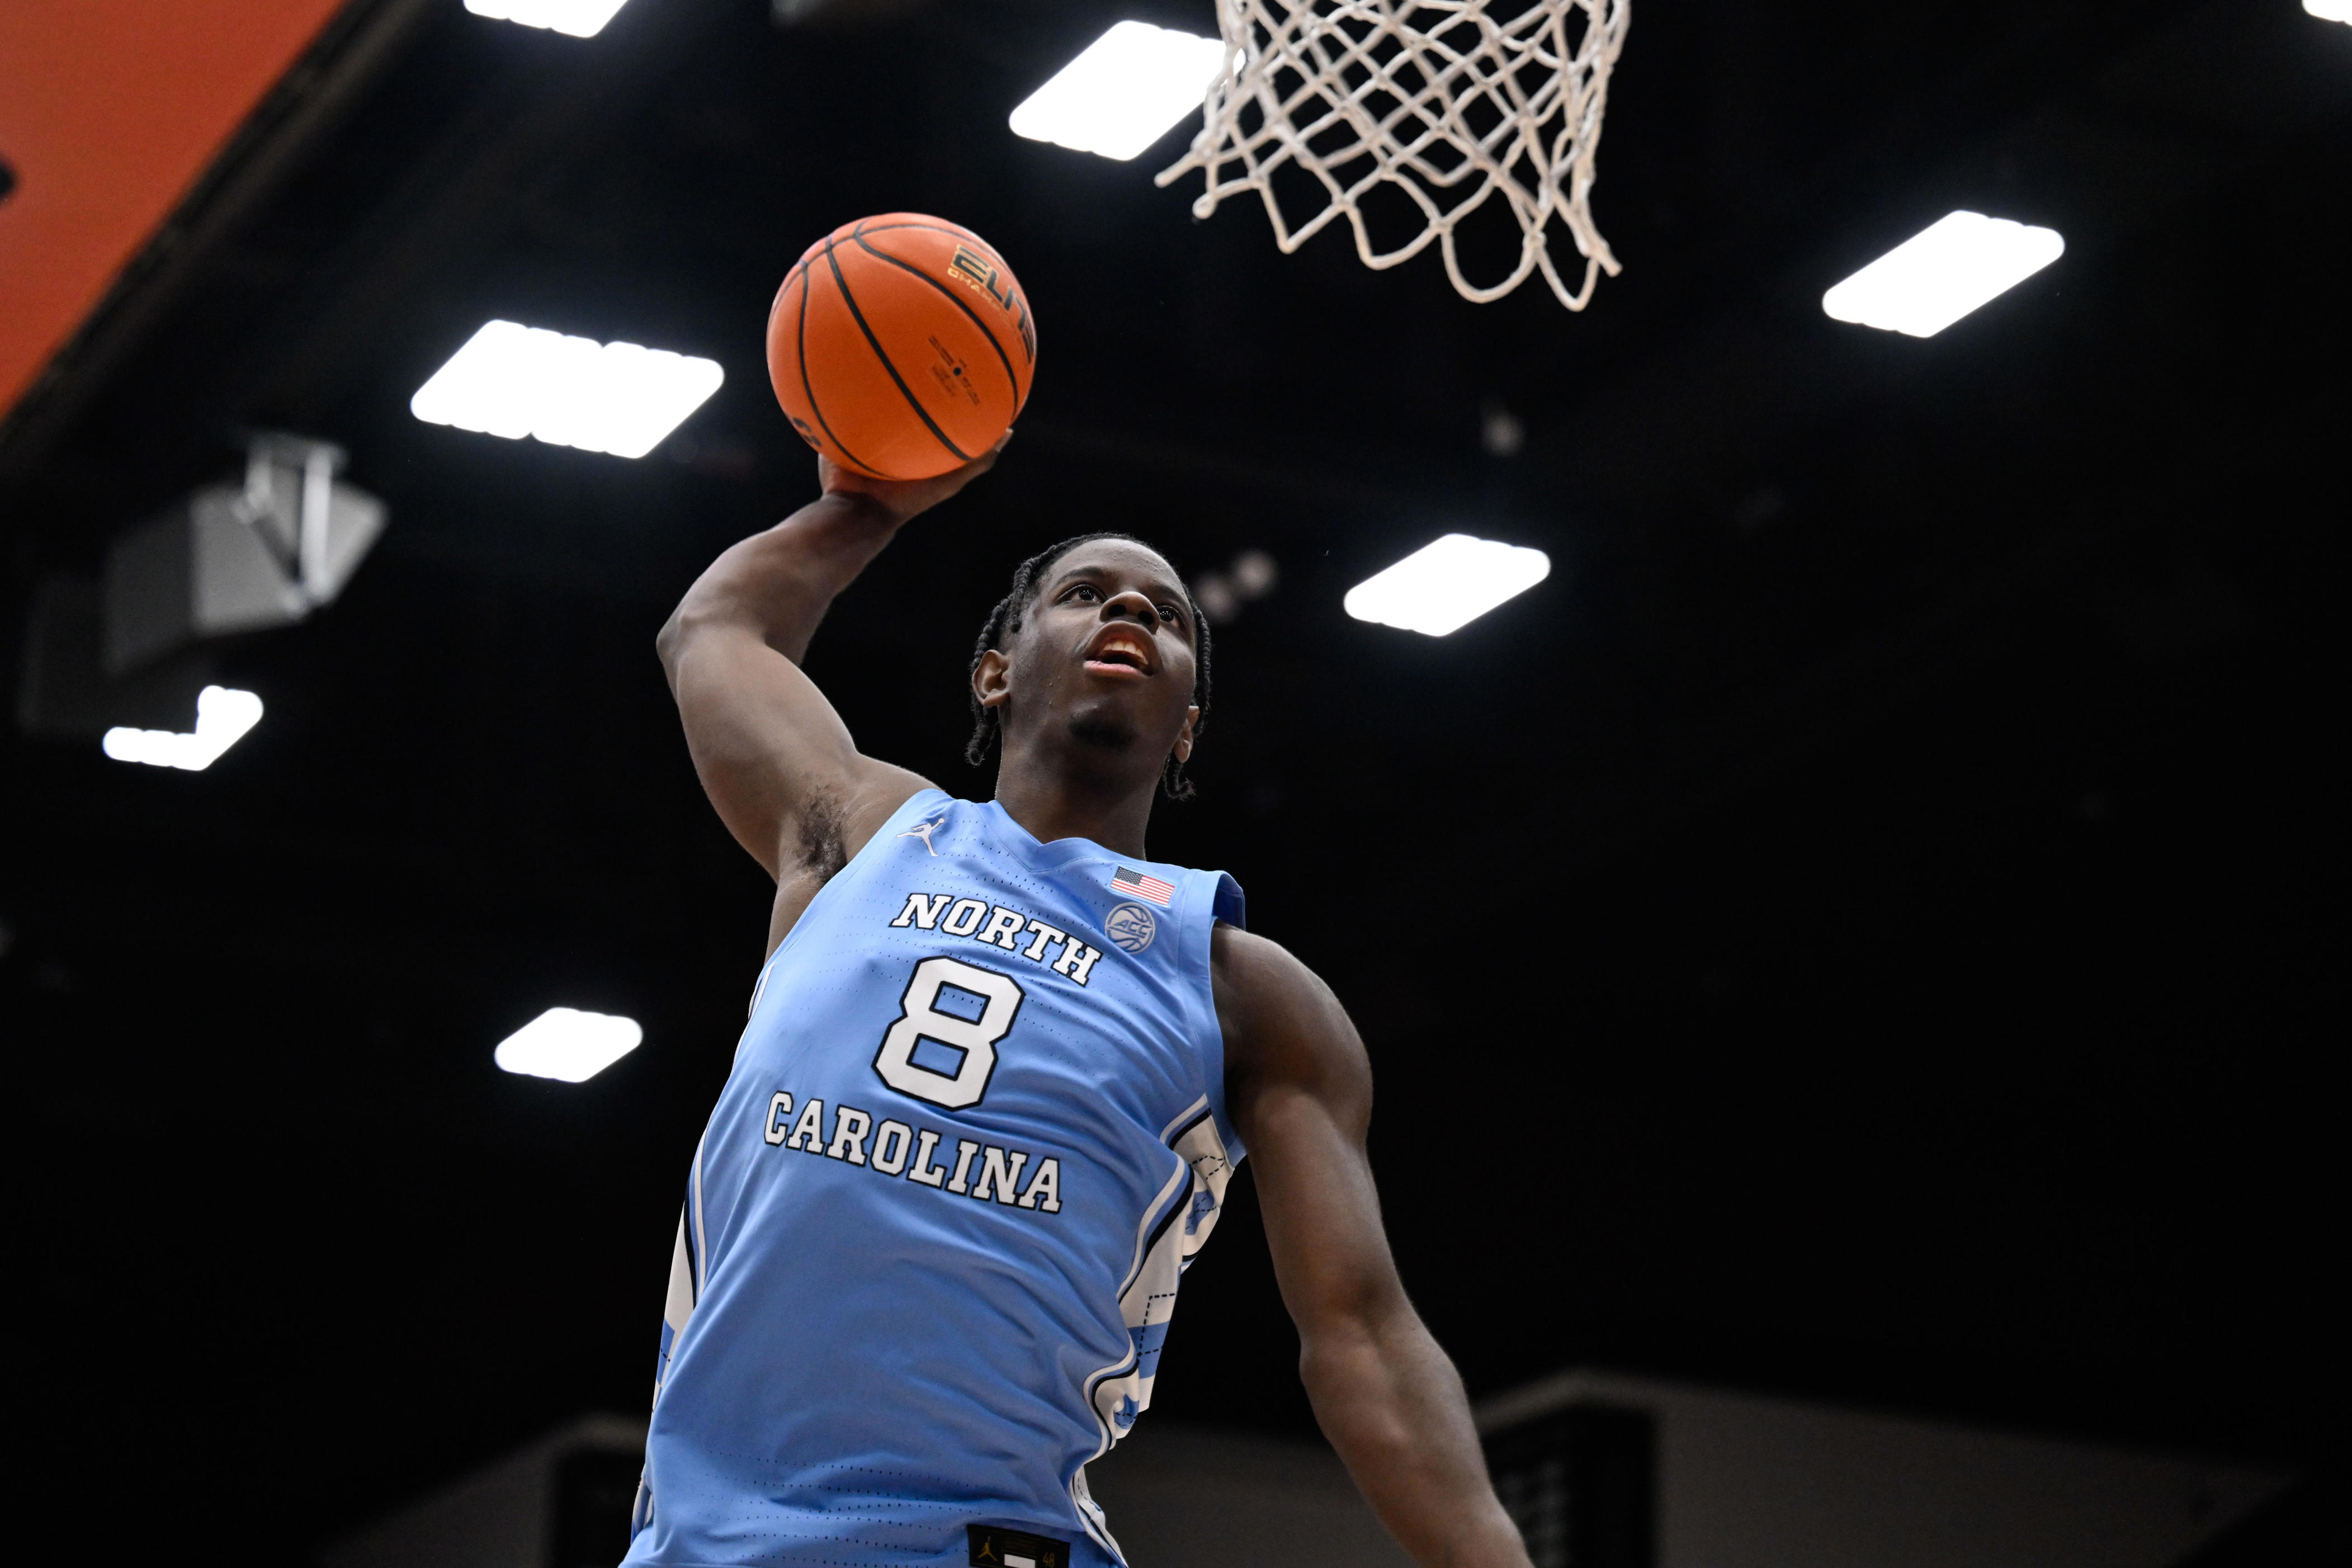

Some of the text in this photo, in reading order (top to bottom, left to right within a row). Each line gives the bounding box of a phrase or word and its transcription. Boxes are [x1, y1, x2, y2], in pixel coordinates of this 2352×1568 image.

[889, 893, 1103, 987] NORTH
[1113, 920, 1152, 936] ACC
[872, 956, 1026, 1111] 8
[763, 1090, 1062, 1215] CAROLINA
